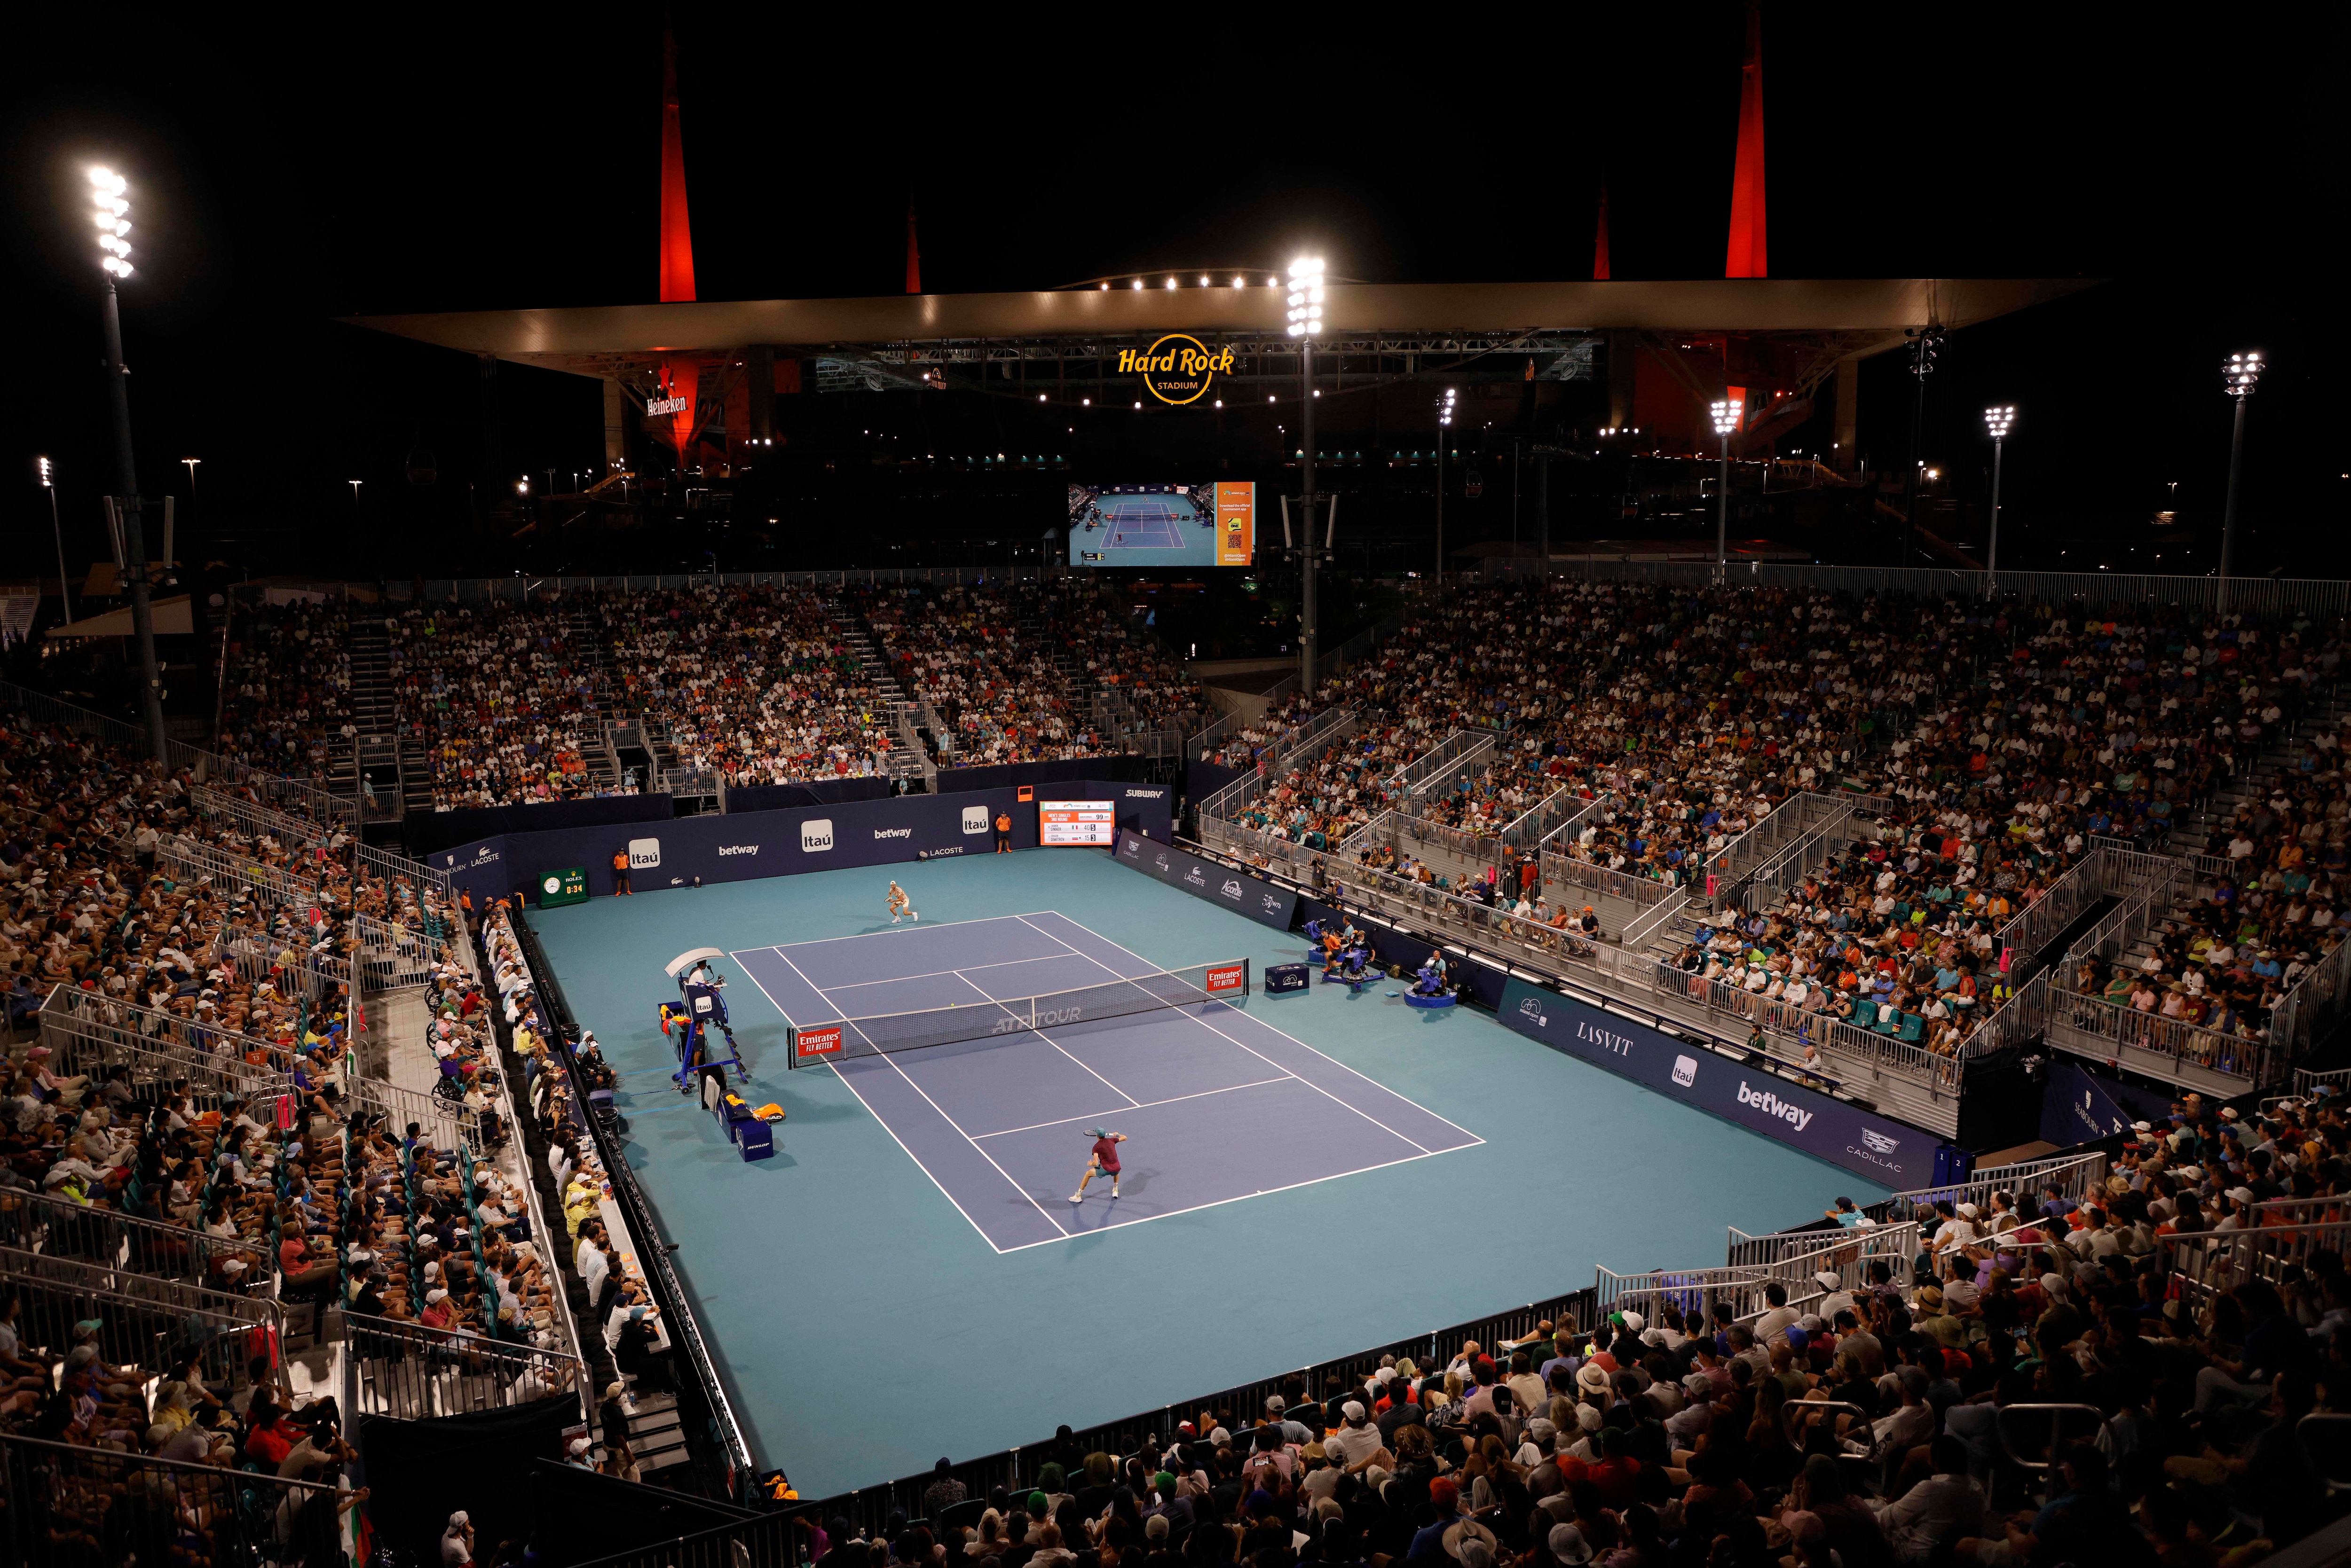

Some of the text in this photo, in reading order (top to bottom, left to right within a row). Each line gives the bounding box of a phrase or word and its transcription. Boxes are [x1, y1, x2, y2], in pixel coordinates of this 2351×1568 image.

[1119, 348, 1234, 376] Hard Rock
[647, 395, 686, 416] Heineken
[1125, 789, 1163, 798] SUBWAY
[965, 819, 986, 830] Itaú
[874, 828, 911, 839] betway
[804, 835, 830, 848] Itaú
[718, 845, 759, 856] betway
[930, 847, 963, 857] LACOSTE
[1123, 851, 1139, 859] CADILLAC
[471, 852, 499, 867] LACOSTE
[631, 852, 658, 864] Itaú
[436, 864, 466, 877] SEABOURN
[1184, 873, 1205, 887] LACOSTE
[566, 884, 583, 894] 0:34
[1222, 879, 1243, 897] Acordis
[1209, 971, 1239, 981] Emirates
[697, 1003, 710, 1013] Itaú
[991, 1007, 1081, 1033] ATP TOUR
[800, 1033, 838, 1045] Emirates
[816, 1041, 833, 1050] BETTER
[1577, 1022, 1633, 1056] LASVIT
[1673, 1067, 1692, 1083] Itaú
[1737, 1081, 1813, 1131] betway
[2075, 1102, 2098, 1135] SEABOURN
[1846, 1146, 1901, 1173] CADILLAC
[1840, 1248, 1854, 1263] EXIT
